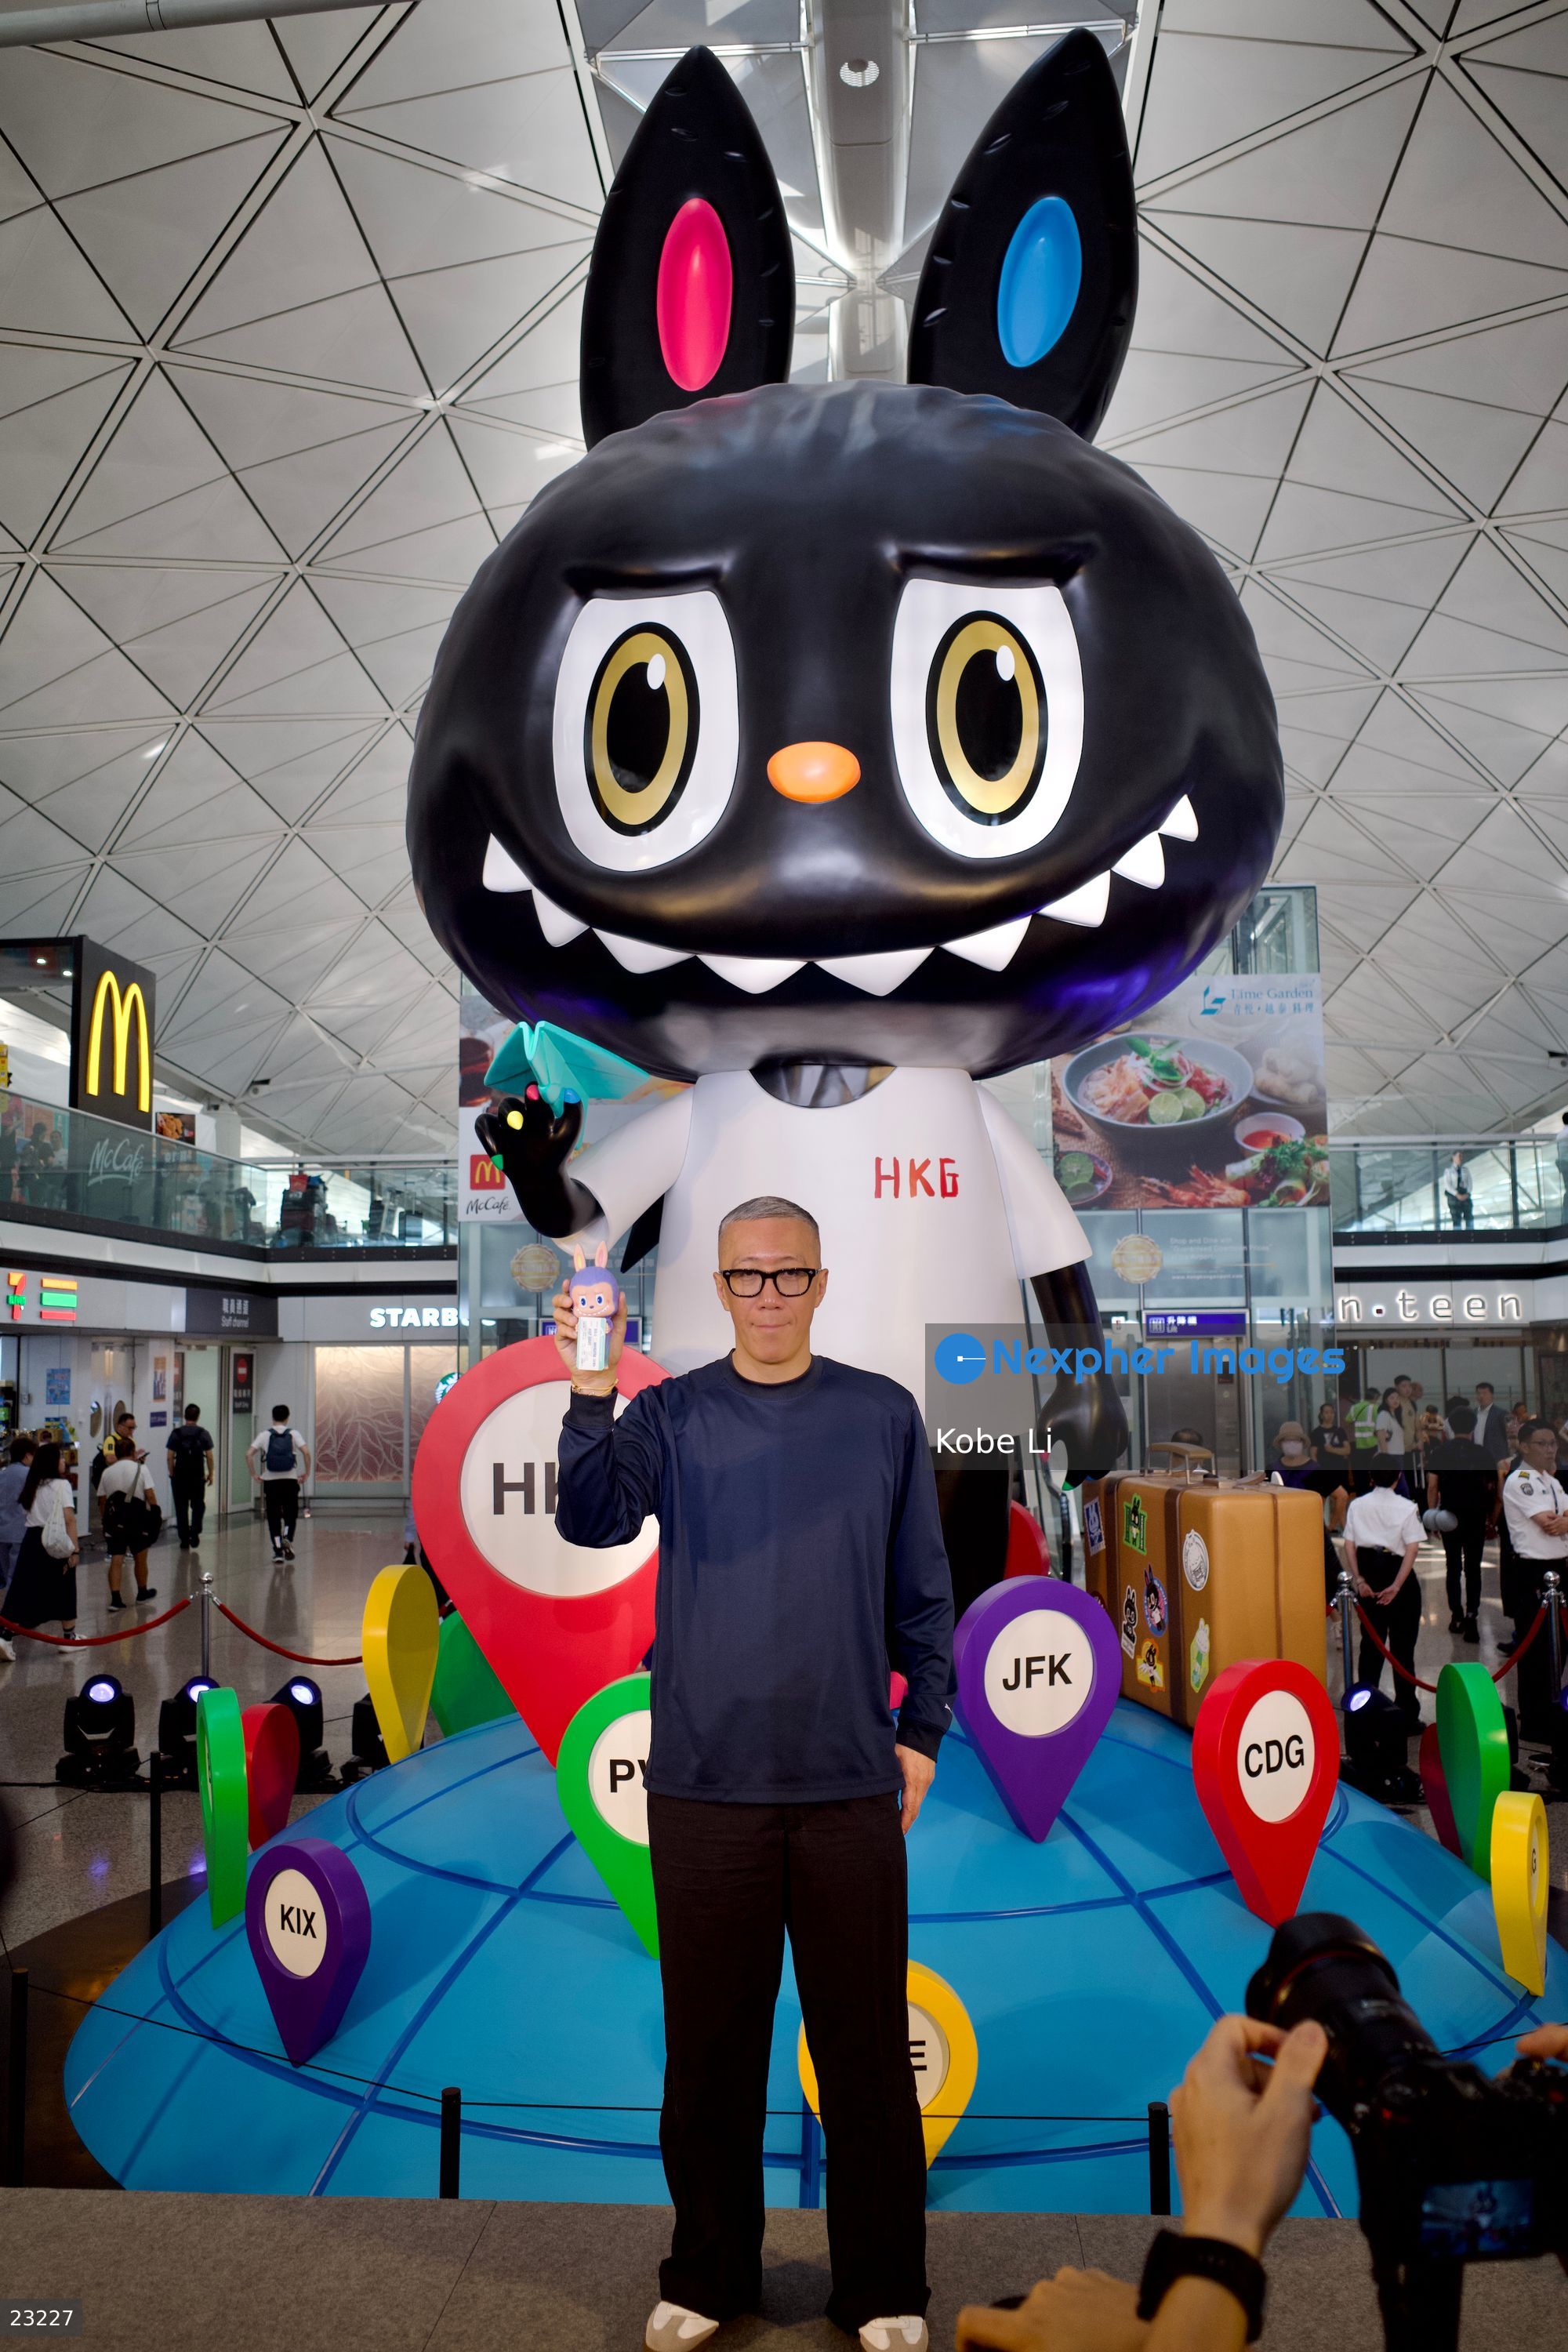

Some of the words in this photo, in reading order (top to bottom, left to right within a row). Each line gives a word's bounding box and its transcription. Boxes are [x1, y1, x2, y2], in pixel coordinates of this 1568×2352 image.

[1232, 989, 1263, 999] Lime
[1267, 988, 1313, 999] Garden
[88, 1138, 144, 1185] McCafé
[874, 1156, 960, 1199] HKG
[466, 1196, 509, 1214] McCafé
[370, 1307, 496, 1328] STARB
[1003, 1653, 1073, 1691] JFK
[1244, 1734, 1305, 1778] CDG
[281, 1904, 317, 1939] KIX
